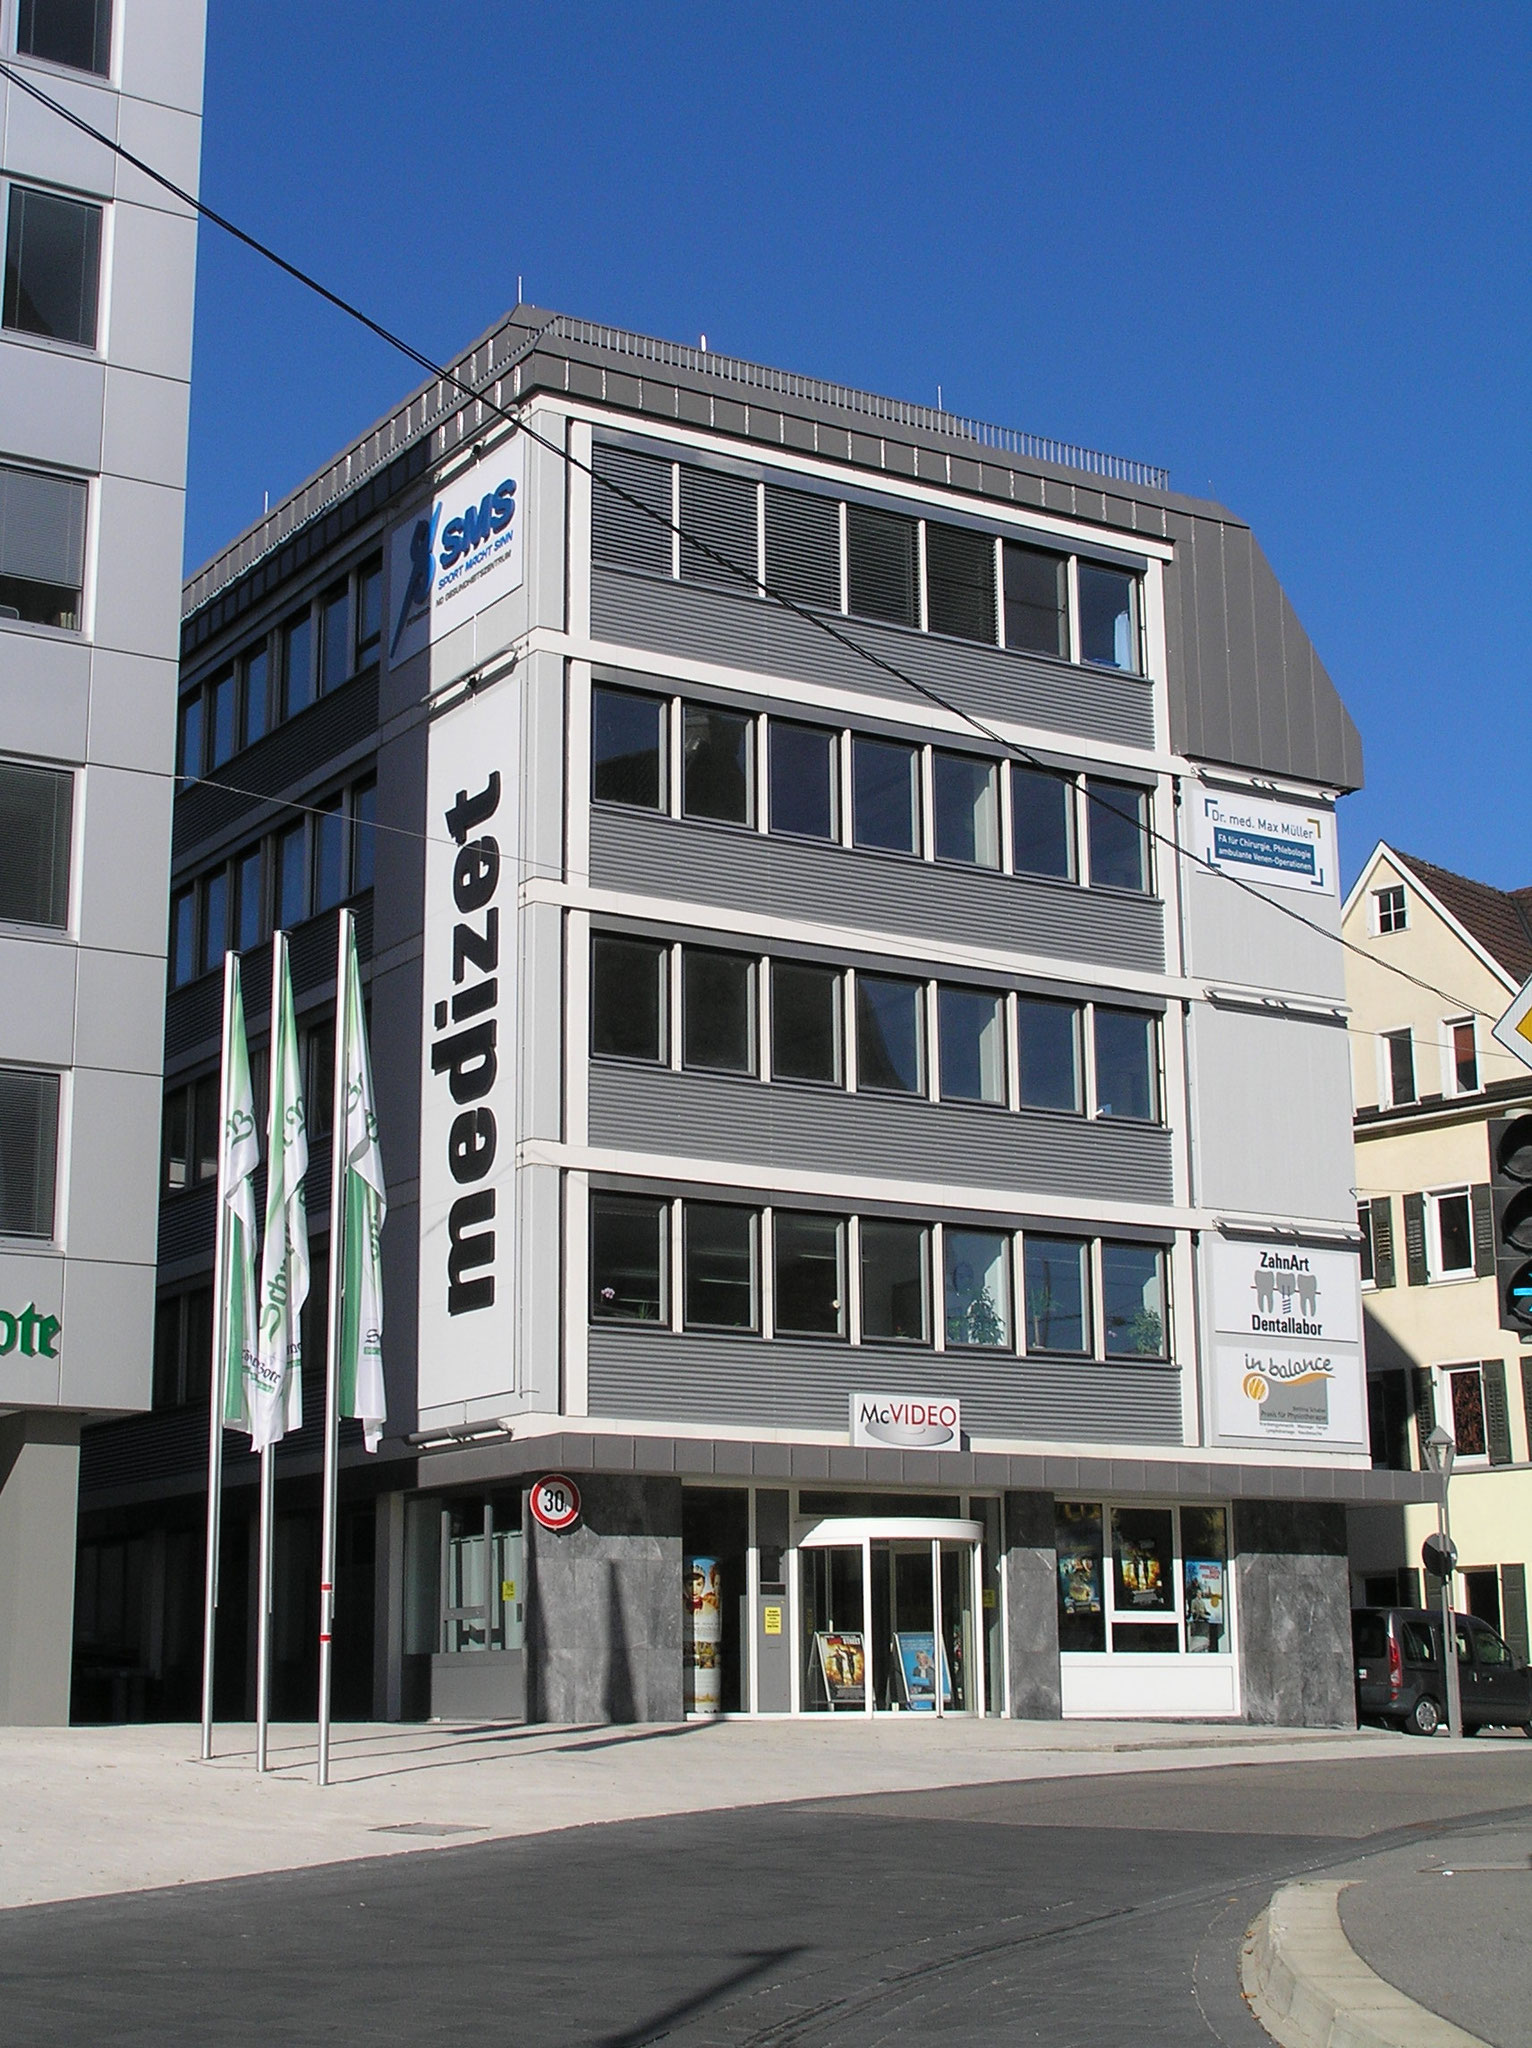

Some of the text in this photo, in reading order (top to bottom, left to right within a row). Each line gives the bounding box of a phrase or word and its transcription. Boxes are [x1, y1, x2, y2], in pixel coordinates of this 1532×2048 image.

[439, 478, 518, 571] SMS
[437, 529, 514, 590] SPORT MACHT SINN
[1211, 809, 1314, 840] Dr. med. Max Müller
[1218, 833, 1228, 844] FA
[431, 769, 502, 1317] medizet
[1259, 1251, 1310, 1272] ZahnArt
[1251, 1314, 1323, 1336] Dentallabor
[1245, 1353, 1335, 1379] in balance
[860, 1402, 957, 1427] McVIDEO
[544, 1489, 565, 1512] 30
